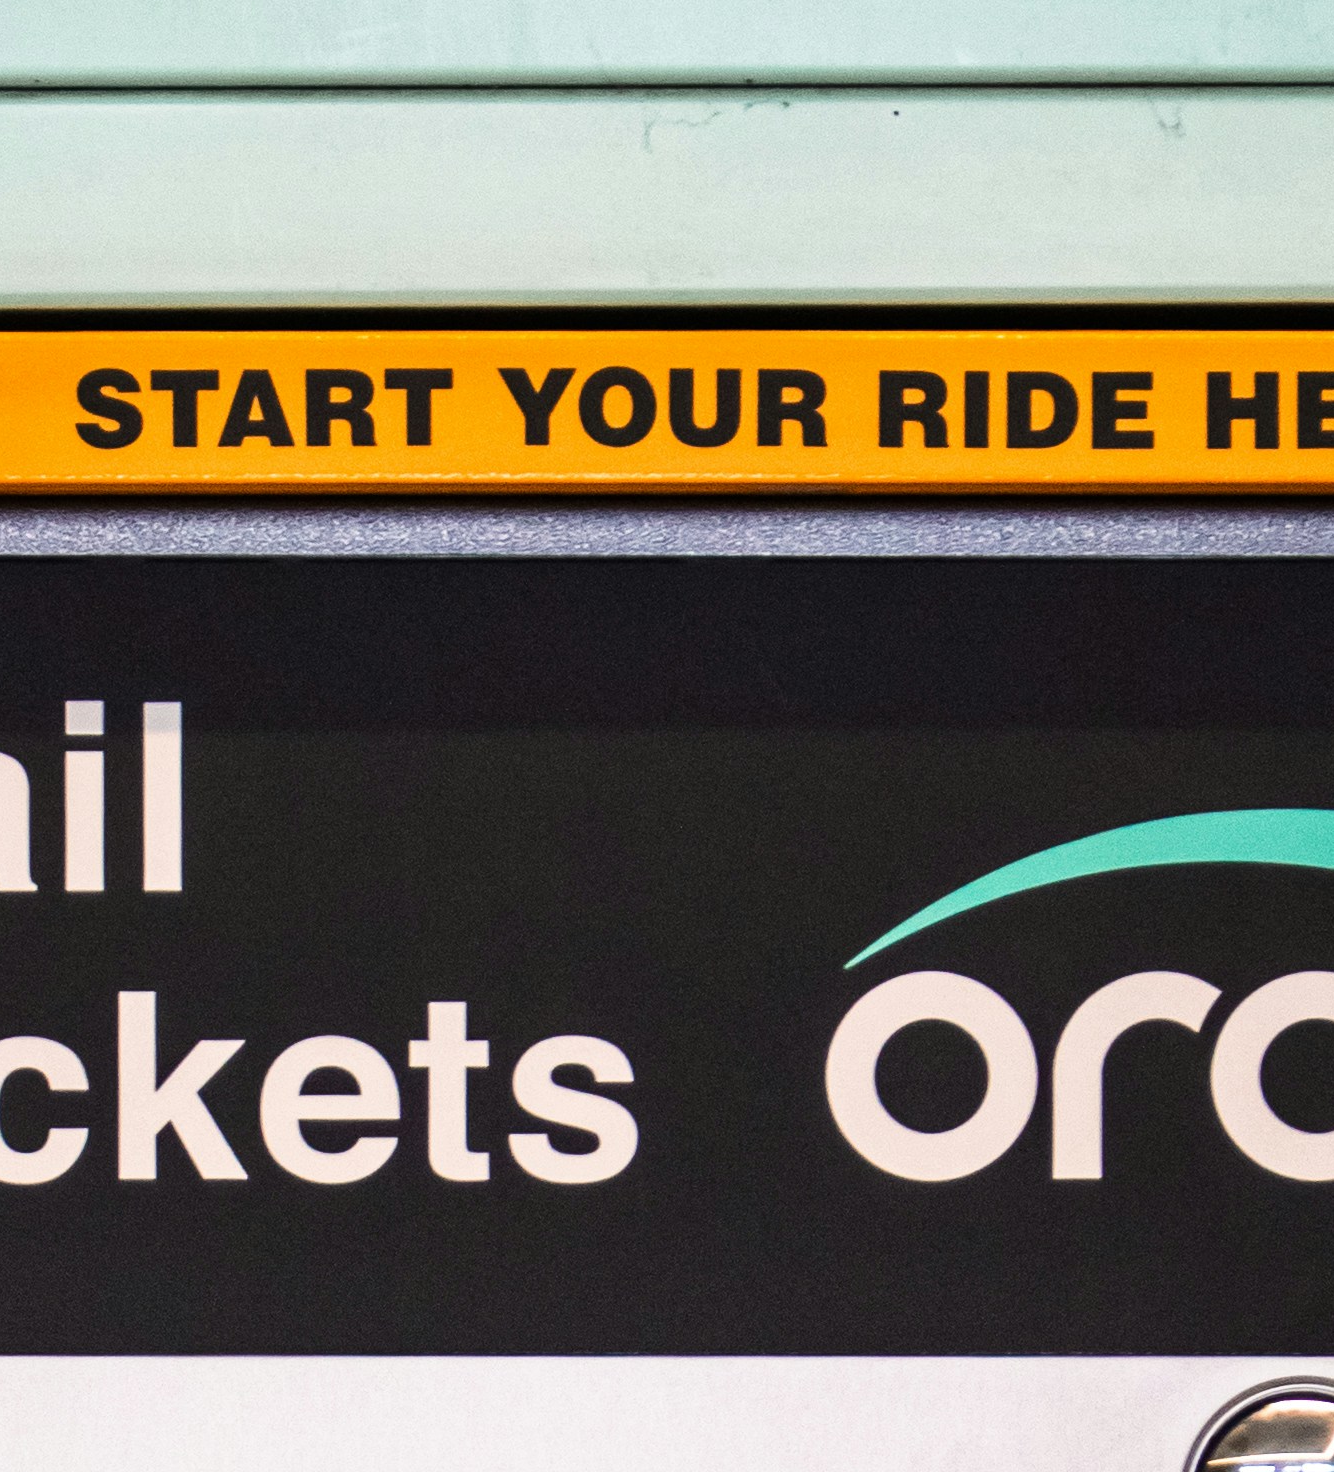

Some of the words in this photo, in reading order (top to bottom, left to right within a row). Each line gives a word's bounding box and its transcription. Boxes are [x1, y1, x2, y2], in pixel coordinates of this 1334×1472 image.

[76, 368, 453, 449] START
[498, 366, 827, 447] YOUR
[879, 370, 1154, 449] RIDE
